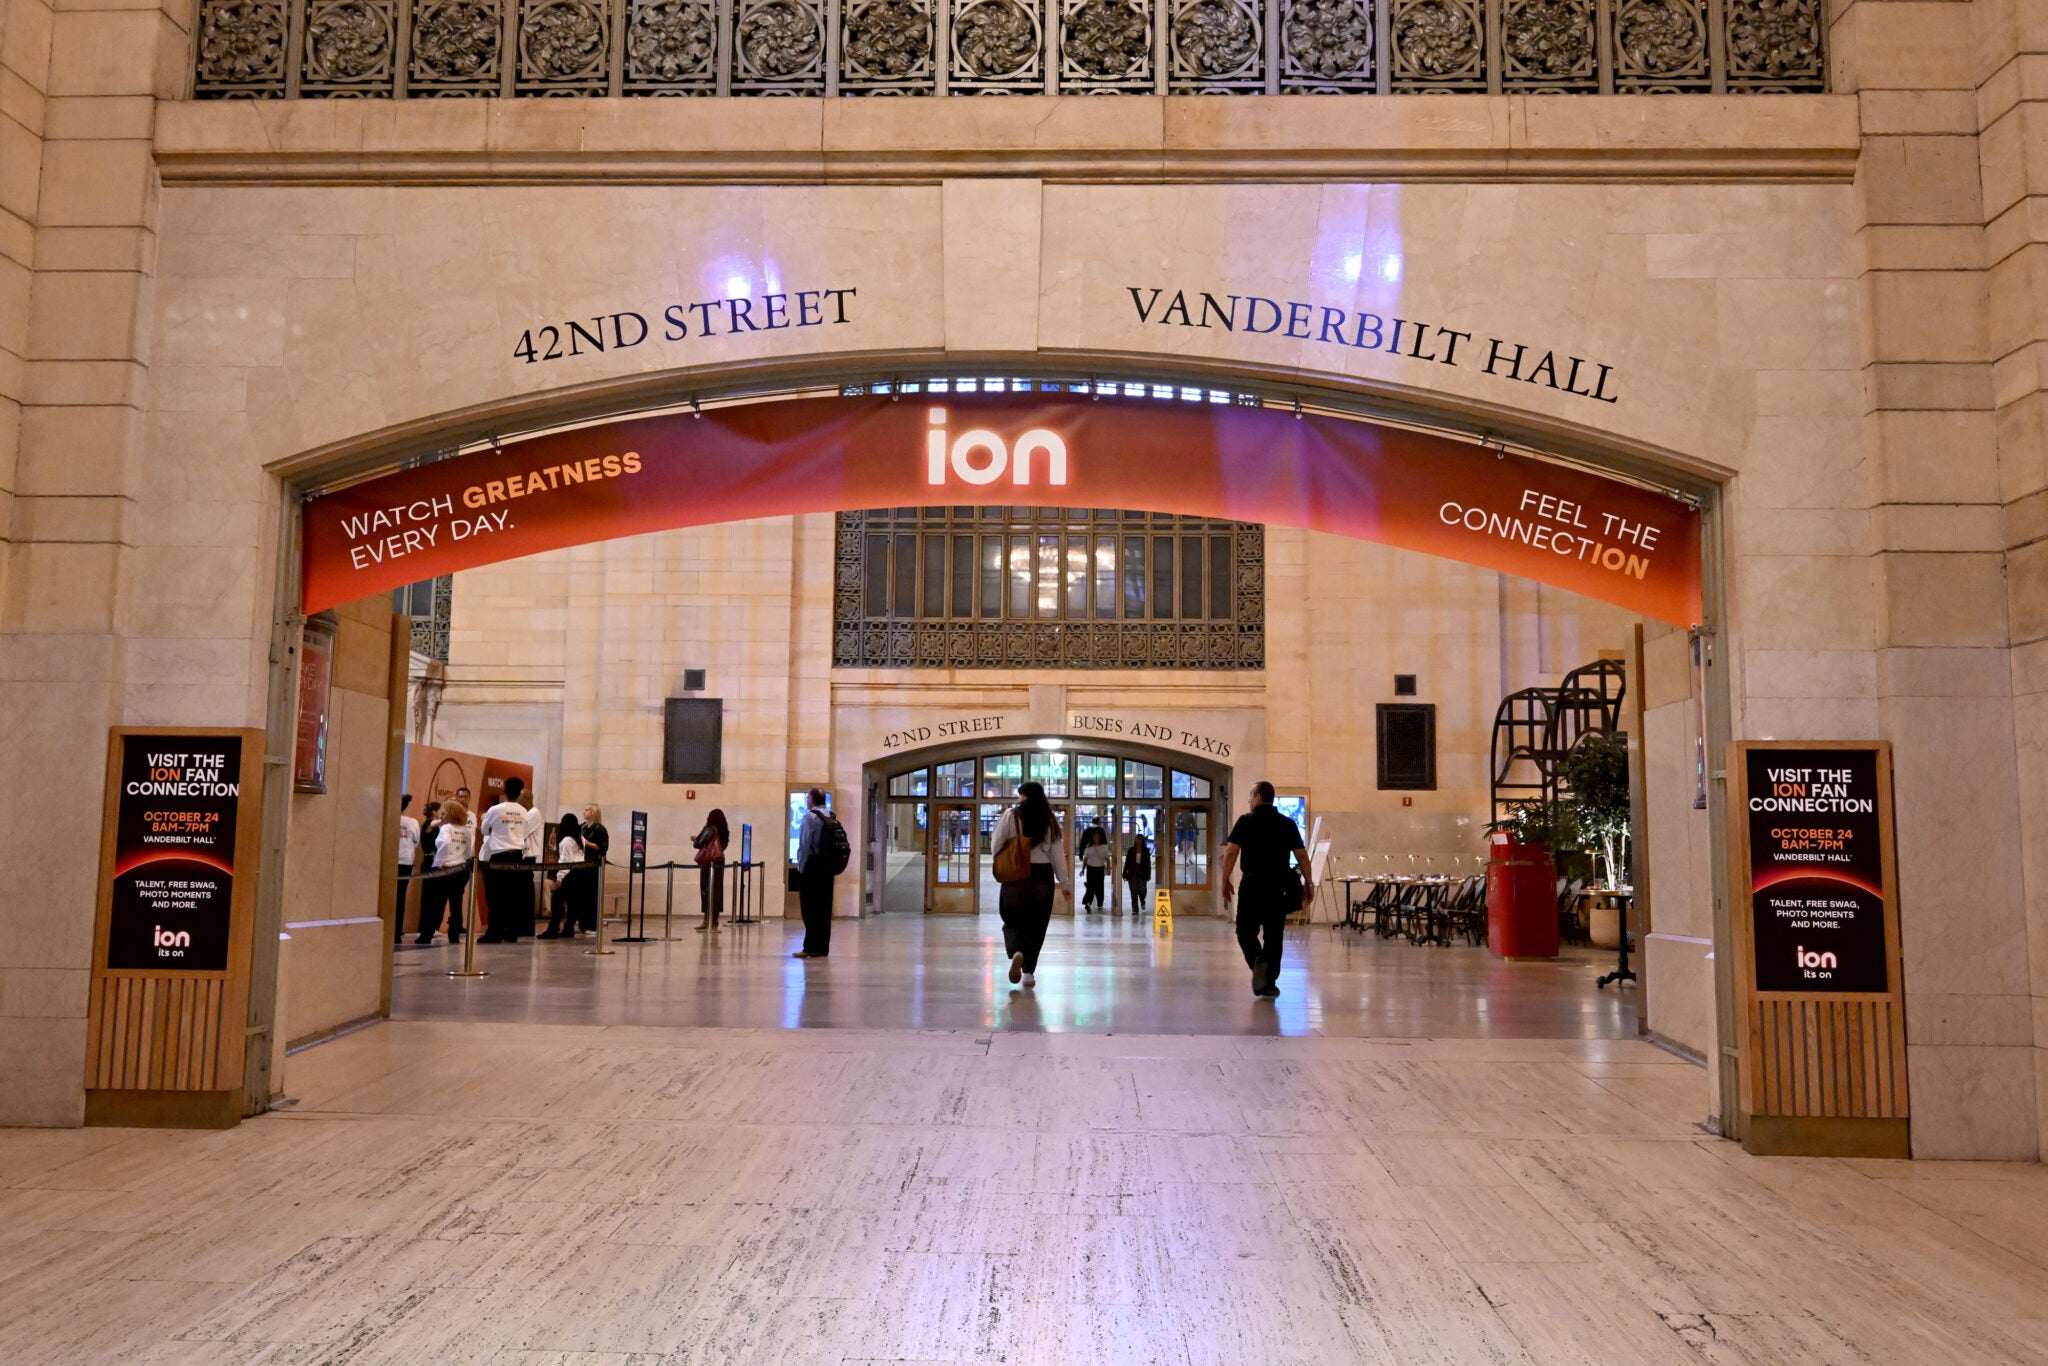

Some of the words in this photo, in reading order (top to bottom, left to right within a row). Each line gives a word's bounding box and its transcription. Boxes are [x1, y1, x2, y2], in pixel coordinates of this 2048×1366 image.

[514, 312, 648, 364] 42ND
[664, 287, 856, 341] STREET
[1127, 287, 1472, 366] VANDERBILT
[1481, 338, 1618, 404] HALL
[928, 408, 1067, 485] ion
[340, 494, 454, 540] WATCH
[462, 451, 642, 508] GREATNESS
[1520, 489, 1588, 529] FEEL
[1601, 512, 1661, 551] THE
[350, 524, 438, 570] EVERY
[450, 510, 515, 540] DAY.
[1439, 502, 1650, 580] CONNECTION
[884, 726, 931, 748] 42ND
[938, 716, 1004, 737] STREET
[1072, 716, 1123, 732] BUSES
[1130, 722, 1172, 741] AND
[1180, 731, 1232, 758] TAXIS
[148, 754, 188, 768] VISIT
[193, 754, 225, 768] THE
[150, 768, 181, 782] ION
[186, 768, 218, 782] FAN
[996, 764, 1062, 778] PERHING
[1767, 769, 1812, 782] VISIT
[1816, 769, 1852, 783] THE
[126, 782, 240, 797] CONNECTION
[1773, 783, 1806, 798] ION
[1811, 783, 1848, 798] FAN
[1749, 798, 1873, 813] CONNECTION
[144, 812, 200, 822] OCTOBER
[204, 812, 219, 822] 24
[144, 836, 192, 844] VANDERBILT
[1771, 828, 1833, 839] OCTOBER
[1836, 829, 1853, 840] 24
[1773, 853, 1826, 862] VANDERBILT
[135, 880, 166, 889] TALENT,
[168, 880, 188, 888] FREE
[190, 881, 218, 890] SWAG,
[140, 890, 169, 898] PHOTO
[170, 891, 212, 899] MOMENTS
[152, 900, 170, 908] AND
[172, 901, 198, 909] MORE.
[1770, 900, 1804, 909] TALENT,
[1806, 900, 1828, 908] FREE
[1829, 900, 1860, 910] SWAG,
[1776, 910, 1808, 918] PHOTO
[1810, 910, 1854, 919] MOMENTS
[1790, 920, 1810, 928] AND
[1812, 920, 1841, 929] MORE.
[154, 925, 190, 948] ion
[172, 950, 184, 958] on
[1797, 946, 1836, 968] ion
[1818, 970, 1832, 979] on
